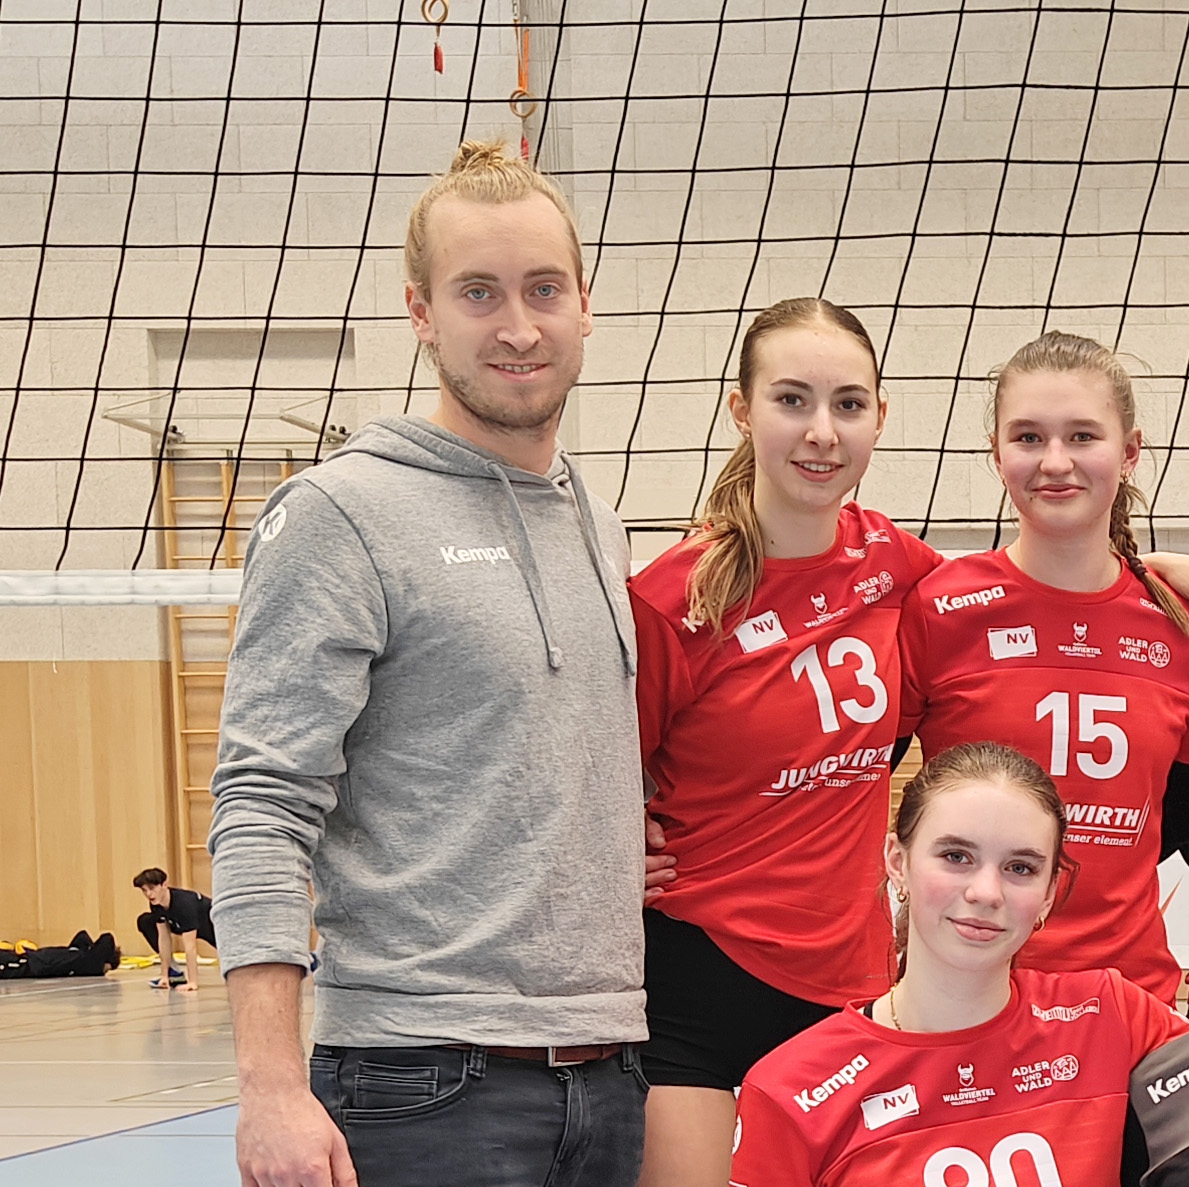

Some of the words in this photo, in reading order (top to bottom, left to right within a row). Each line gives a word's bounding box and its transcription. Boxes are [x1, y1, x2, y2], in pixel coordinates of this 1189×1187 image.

[440, 545, 511, 565] Kempa
[853, 576, 880, 593] ADLER
[934, 586, 1005, 614] Kempa
[752, 619, 774, 634] NV
[1007, 633, 1029, 644] NV
[1118, 636, 1148, 649] ADLER
[1119, 650, 1147, 662] WALD
[790, 636, 888, 733] 13
[1036, 691, 1128, 780] 15
[1065, 804, 1140, 827] WIRTH
[1012, 1061, 1050, 1077] ADLER
[793, 1054, 869, 1112] Kempa
[1015, 1077, 1052, 1093] WALD
[1022, 1073, 1042, 1083] UND
[883, 1093, 909, 1110] NV
[943, 1088, 996, 1103] WALDVIERTEL
